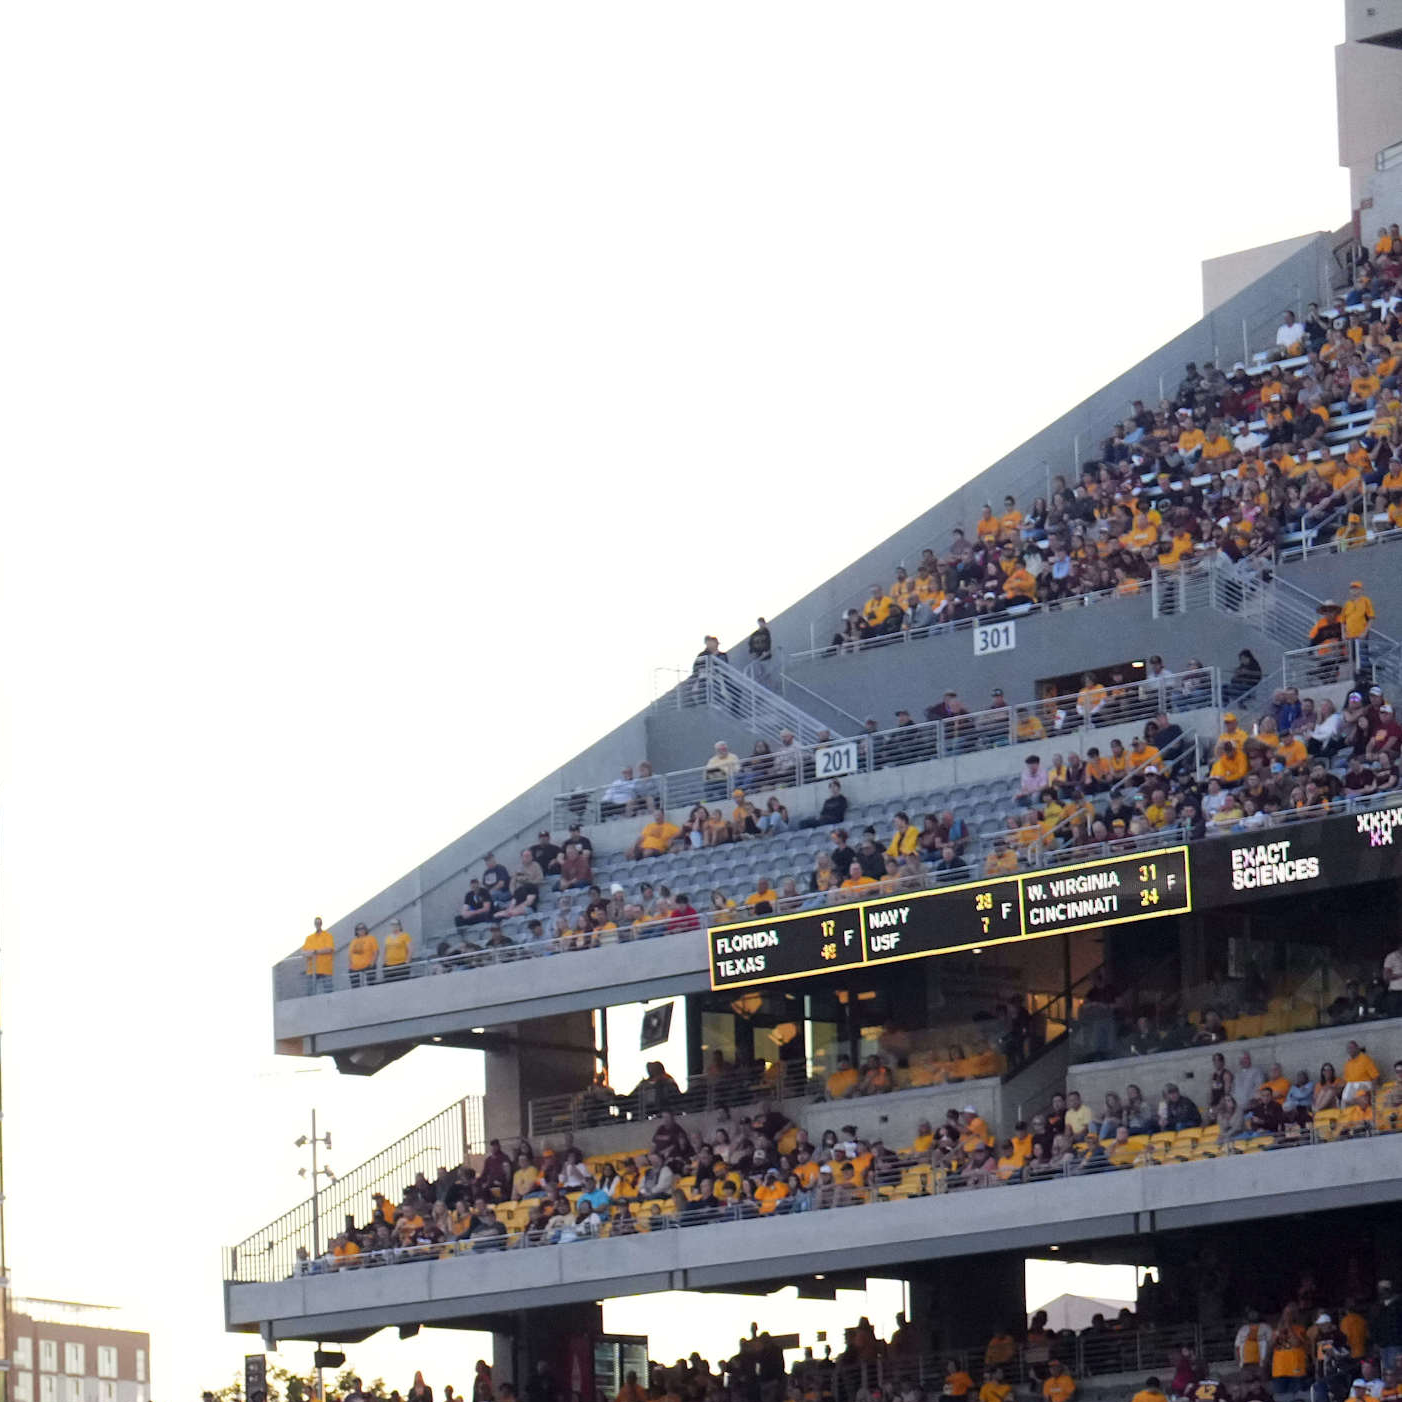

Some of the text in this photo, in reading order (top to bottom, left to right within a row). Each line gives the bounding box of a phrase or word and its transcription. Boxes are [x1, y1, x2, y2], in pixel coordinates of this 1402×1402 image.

[979, 626, 1012, 652] 301
[823, 748, 852, 774] 201
[1231, 840, 1291, 870] EXACT
[1049, 870, 1120, 897] VIRGINIA
[1139, 863, 1157, 882] 31
[1167, 874, 1176, 891] F
[1231, 857, 1320, 891] SCIENCES
[868, 906, 910, 929] NAVY
[1001, 902, 1012, 919] F
[1029, 894, 1119, 926] CINCINNATI
[716, 930, 779, 954] FLORIDA
[844, 929, 855, 947] F
[871, 932, 900, 952] USF
[716, 955, 765, 978] TEXAS
